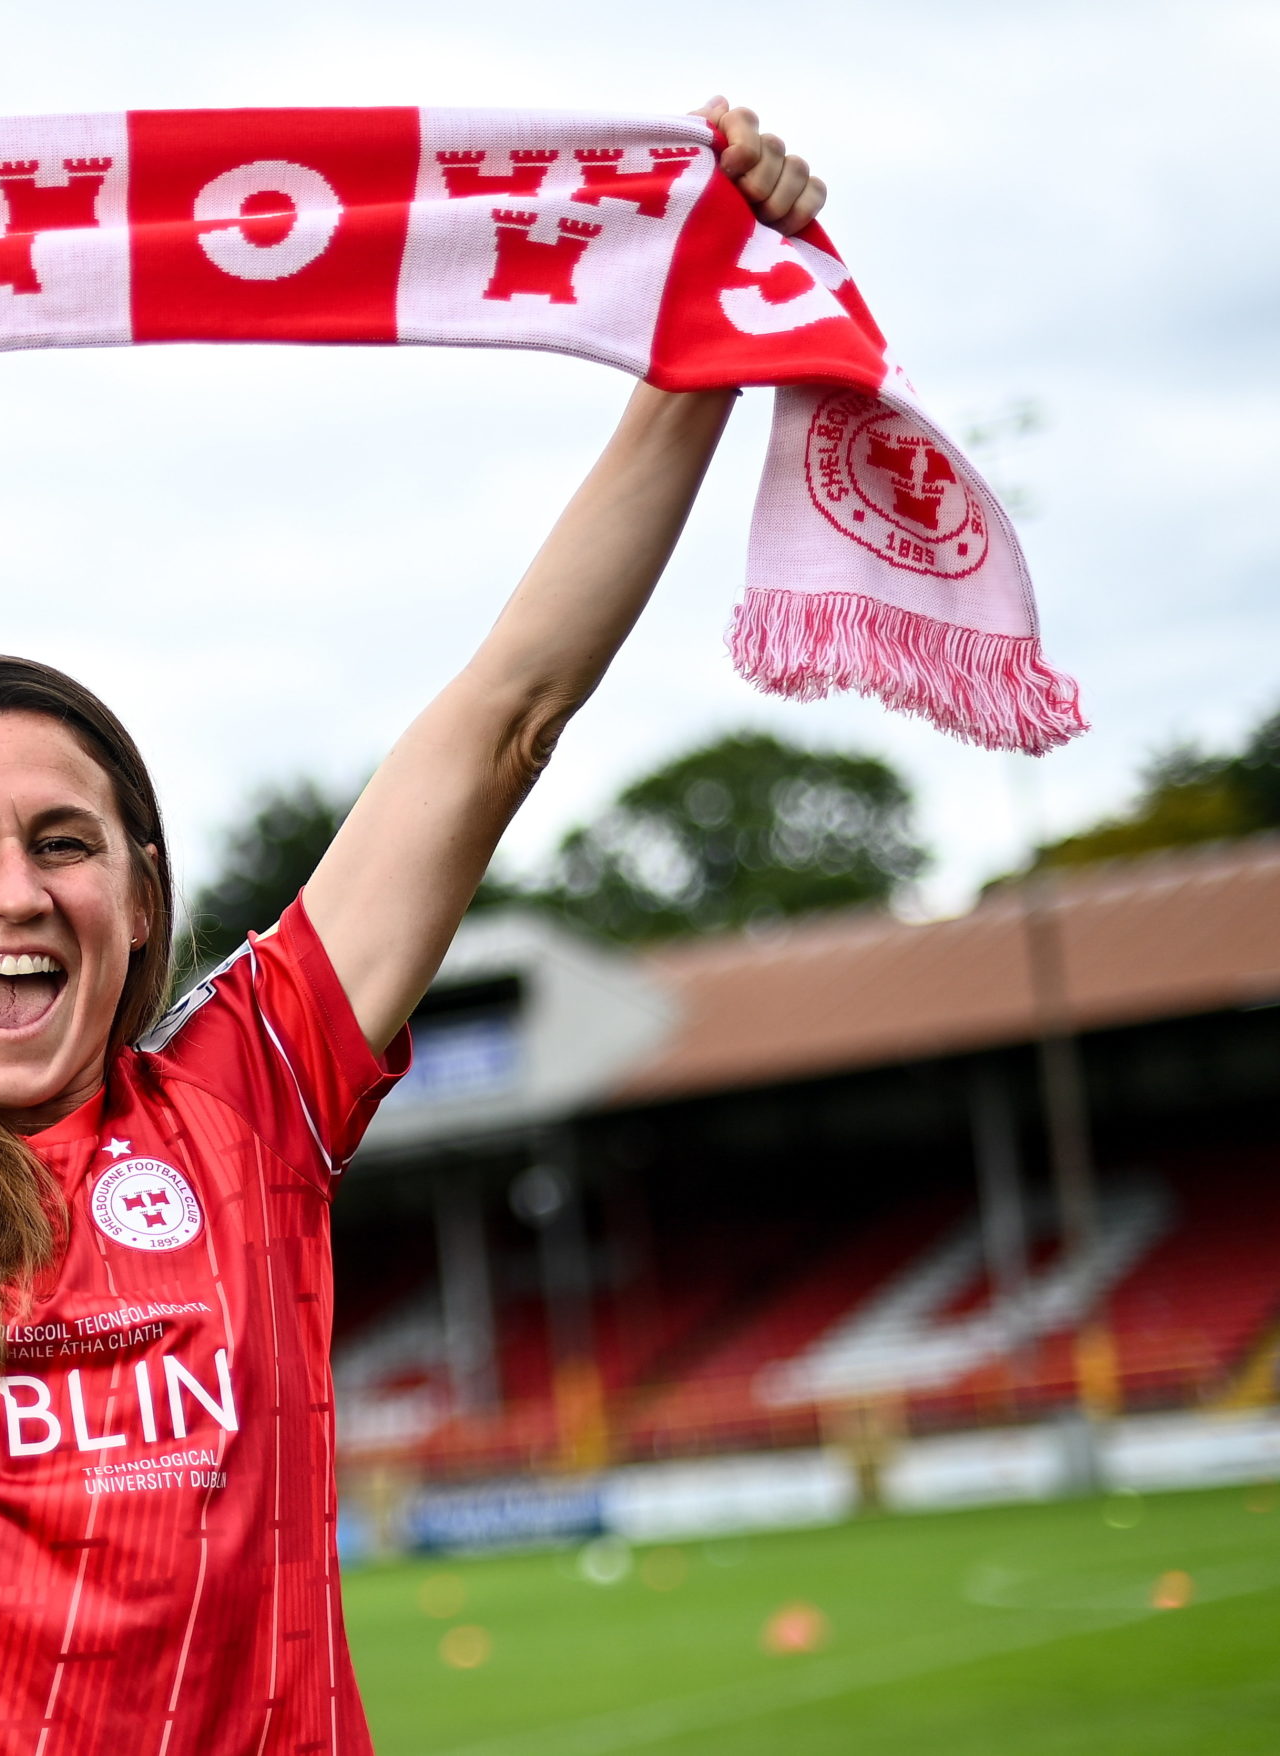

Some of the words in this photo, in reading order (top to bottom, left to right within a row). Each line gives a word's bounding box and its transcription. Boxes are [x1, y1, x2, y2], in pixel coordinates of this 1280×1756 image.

[886, 531, 936, 566] 1895
[96, 1168, 126, 1236] SHELBOURNE
[126, 1162, 187, 1194] FOOTBALL
[184, 1196, 198, 1224] CLUB
[150, 1235, 180, 1248] 1895
[74, 1302, 212, 1337] TEICNEOLAÍOCHTA
[59, 1340, 105, 1356] ÁTHA
[108, 1322, 164, 1350] CLIATH
[82, 1449, 219, 1477] TECHNOLOGICAL
[84, 1471, 184, 1495] UNIVERSITY
